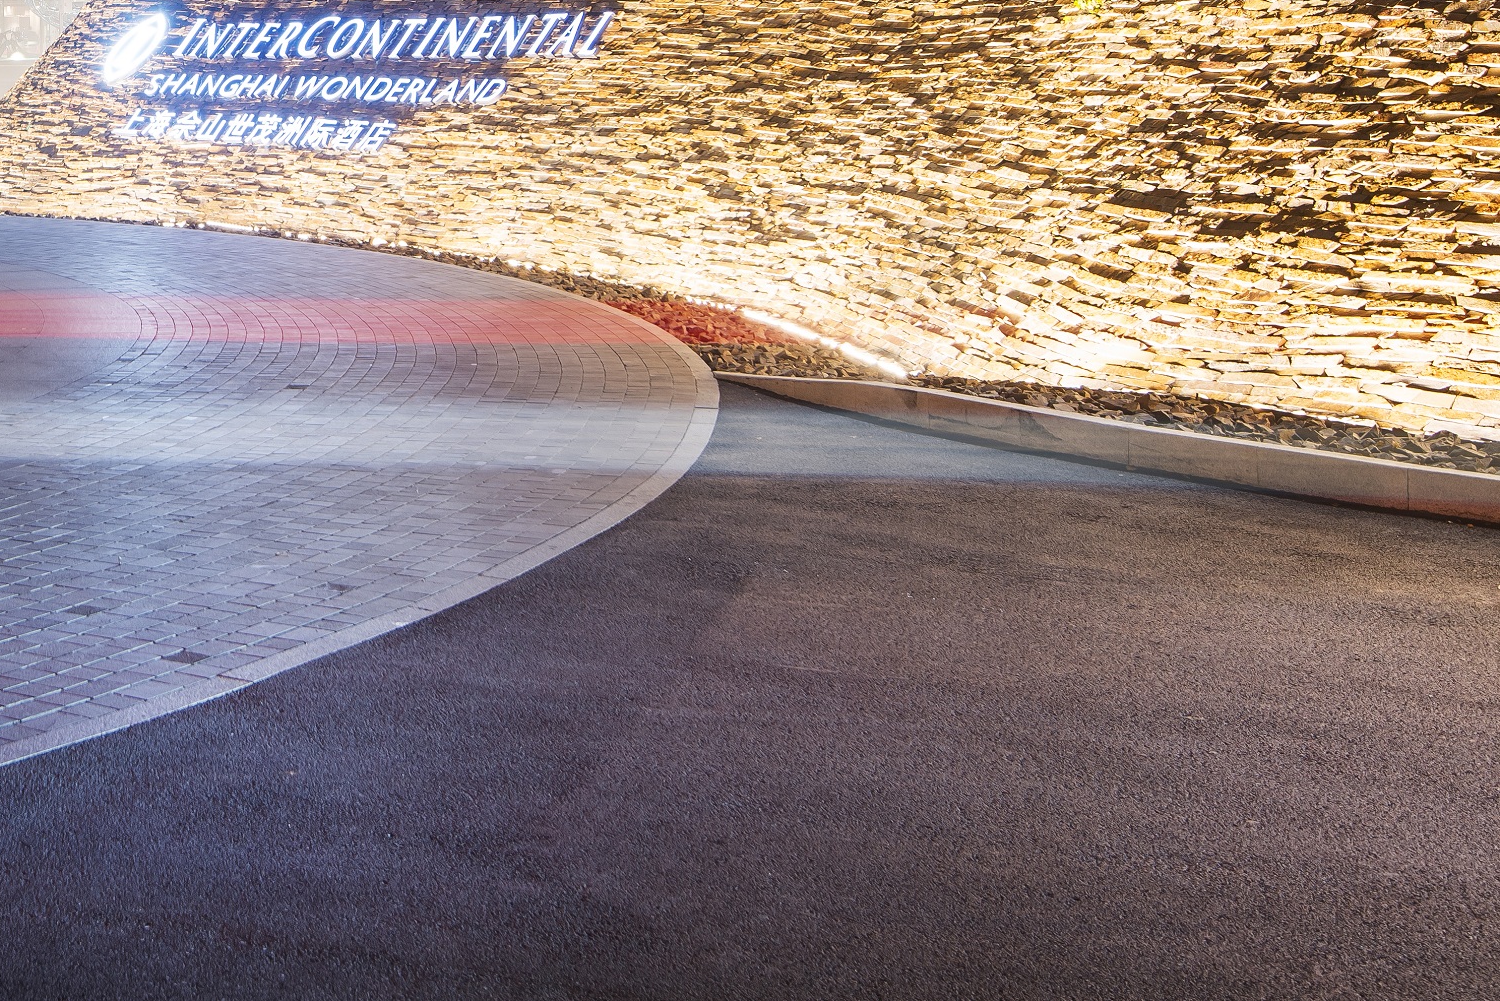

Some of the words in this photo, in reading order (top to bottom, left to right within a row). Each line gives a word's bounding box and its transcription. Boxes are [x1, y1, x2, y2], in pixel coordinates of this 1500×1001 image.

[172, 11, 615, 59] INTERCONTINENTAL
[144, 73, 290, 99] SHANGHAI
[293, 75, 508, 105] WONDERLAND
[114, 108, 397, 150] 上海佘山世茂洲际酒店
